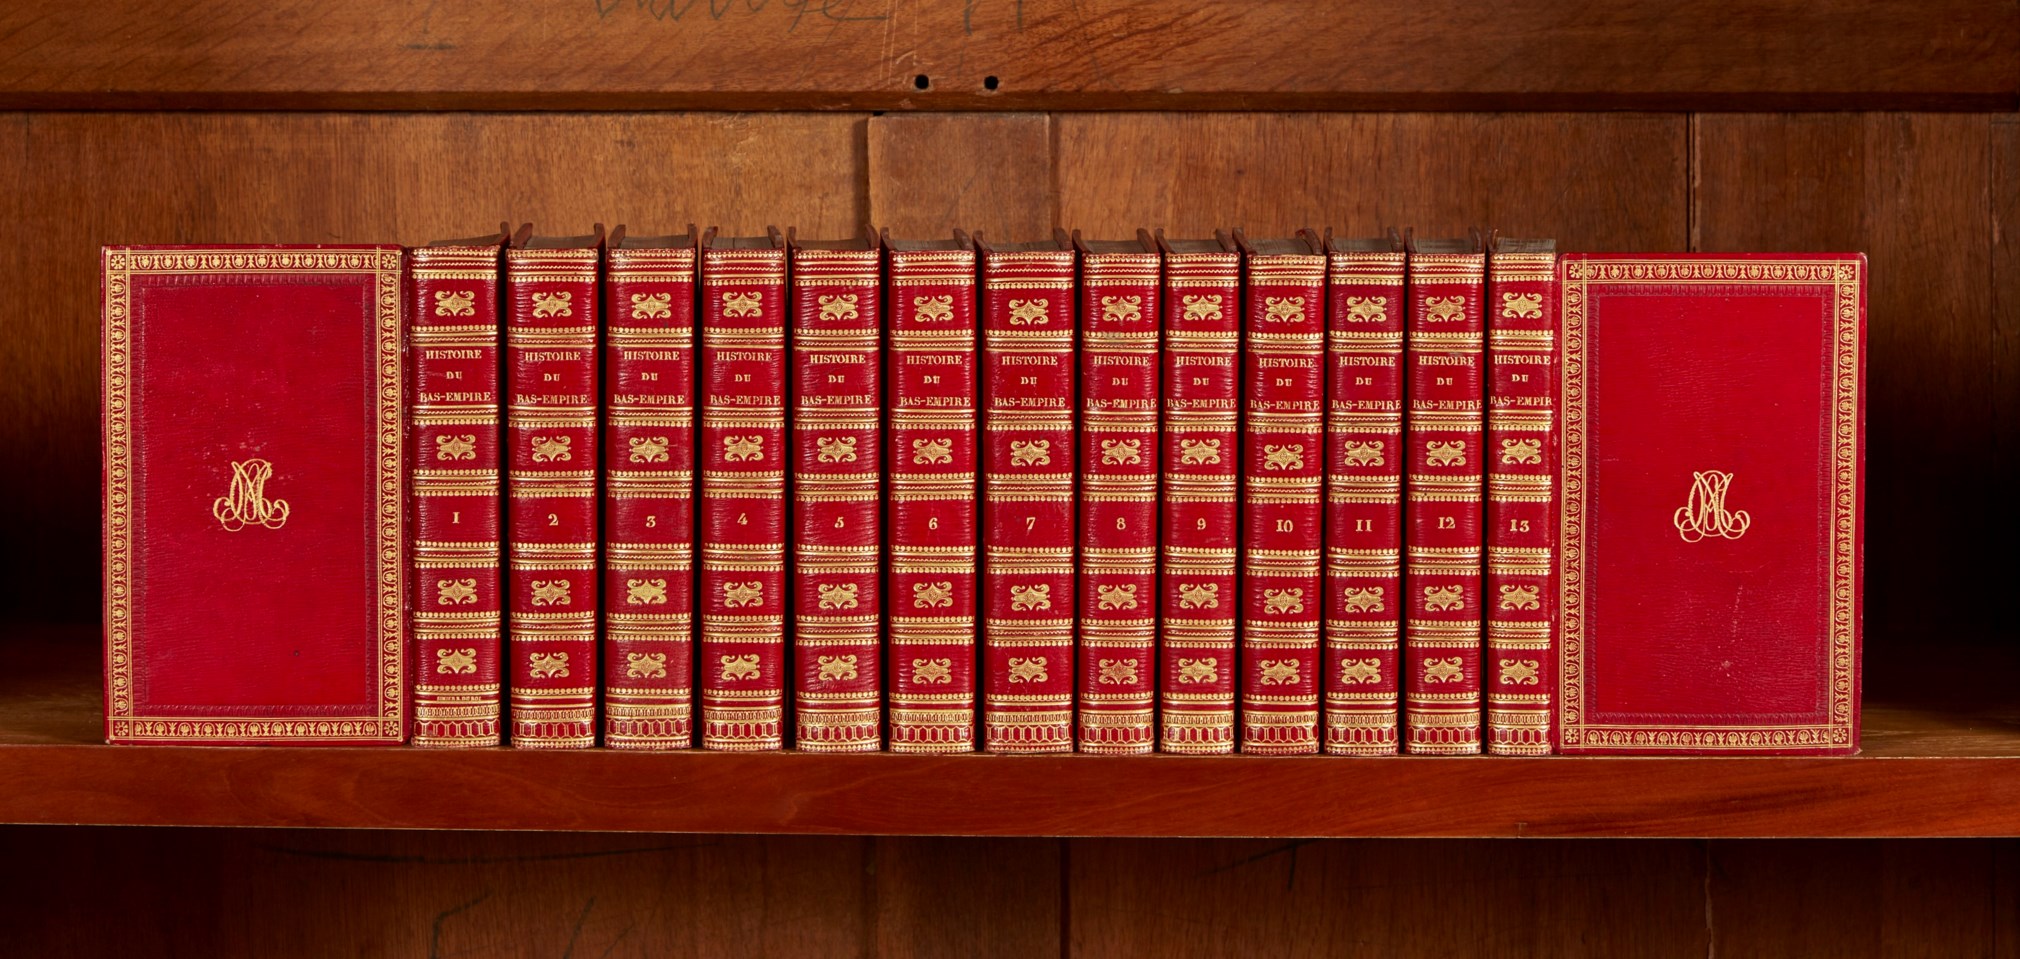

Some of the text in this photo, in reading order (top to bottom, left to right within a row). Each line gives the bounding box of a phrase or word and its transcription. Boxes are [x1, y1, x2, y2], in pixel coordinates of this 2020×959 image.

[426, 350, 482, 360] HISTOIRE
[525, 352, 581, 362] HISTOIRE
[624, 351, 679, 361] HISTOIRE
[716, 352, 772, 361] HISTOIRE
[810, 355, 866, 364] HISTOIRE
[906, 355, 962, 365] HISTOIRE
[1494, 354, 1551, 365] HISTOIRE
[1002, 356, 1058, 365] HISTOIRE
[1094, 356, 1149, 366] HISTOIRE
[1176, 356, 1231, 366] HISTOIRE
[1259, 358, 1314, 368] HISTOIRE
[1339, 356, 1395, 366] HISTOIRE
[1419, 356, 1475, 366] HISTOIRE
[446, 371, 462, 380] DU
[544, 374, 560, 382] DU
[642, 373, 658, 381] DU
[735, 374, 751, 383] DU
[828, 375, 845, 383] DU
[923, 375, 940, 384] DU
[1021, 376, 1037, 385] DU
[1512, 374, 1528, 382] DU
[1112, 377, 1128, 386] DU
[1193, 377, 1209, 385] DU
[1276, 378, 1292, 387] DU
[1356, 377, 1372, 385] DU
[1437, 377, 1452, 385] DU
[420, 392, 491, 402] BAS-EMPIRE
[517, 394, 588, 404] BAS-EMPIRE
[614, 394, 685, 404] BAS-EMPIRE
[710, 395, 780, 405] BAS-EMPIRE
[801, 395, 871, 405] BAS-EMPIRE
[900, 396, 971, 406] BAS-EMPIRE
[994, 397, 1065, 407] BAS-EMPIRE
[1086, 399, 1157, 409] BAS-EMPIRE
[1167, 399, 1236, 408] BAS-EMPIRE
[1250, 400, 1320, 410] BAS-EMPIRE
[1332, 400, 1401, 410] BAS-EMPIRE
[1413, 400, 1482, 410] BAS-EMPIRE
[548, 514, 559, 526] 2
[646, 516, 656, 528] 3
[737, 513, 748, 525] 4
[834, 517, 844, 528] 5
[928, 518, 938, 530] 6
[1026, 517, 1036, 530] 7
[1116, 518, 1126, 530] 8
[1197, 518, 1206, 530] 9
[1438, 517, 1455, 530] 12
[1276, 520, 1293, 532] 10
[1355, 520, 1371, 532] 11
[1510, 520, 1530, 532] 13
